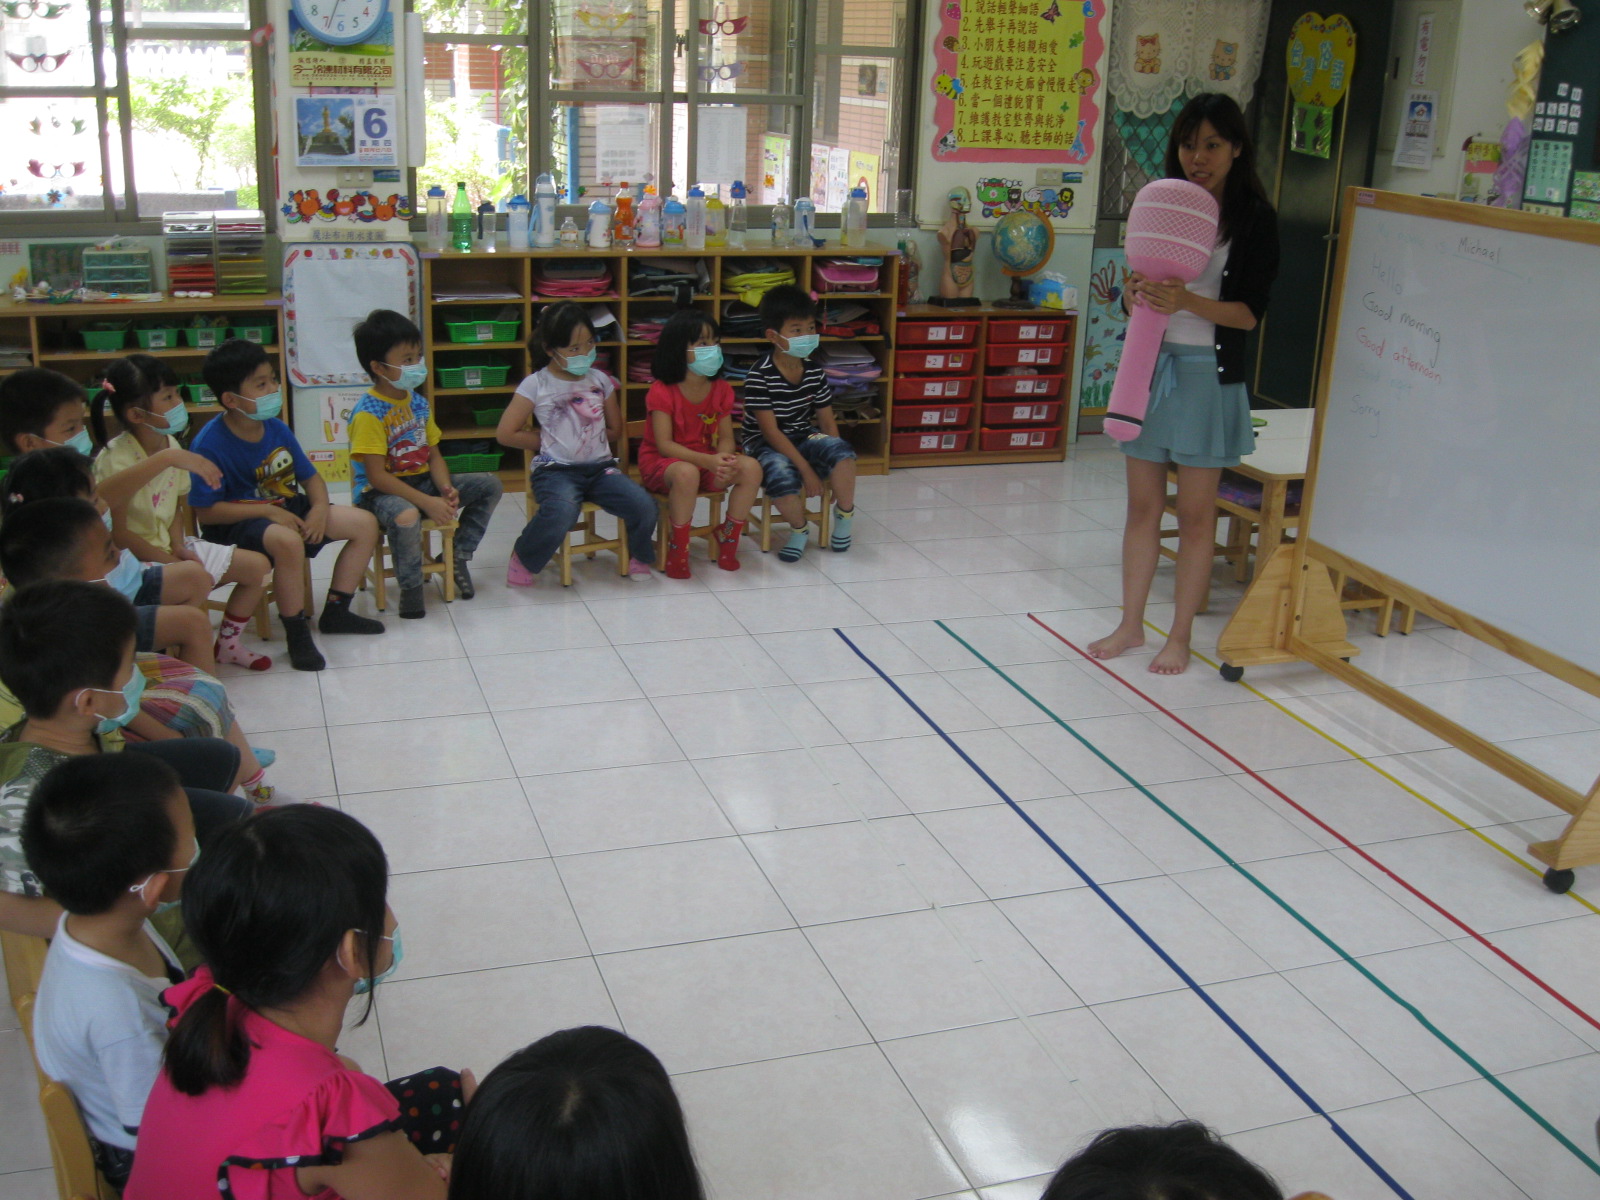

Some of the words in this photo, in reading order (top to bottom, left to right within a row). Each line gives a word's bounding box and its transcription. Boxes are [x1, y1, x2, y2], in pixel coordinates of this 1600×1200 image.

[311, 4, 319, 16] 8
[352, 16, 359, 28] 5
[362, 6, 369, 17] 4
[337, 20, 345, 32] 6
[363, 107, 388, 139] 6
[1458, 236, 1502, 264] Michael
[1371, 253, 1403, 295] Hello
[1362, 291, 1393, 323] Good
[1356, 326, 1386, 359] Good
[1392, 346, 1441, 385] afternoon
